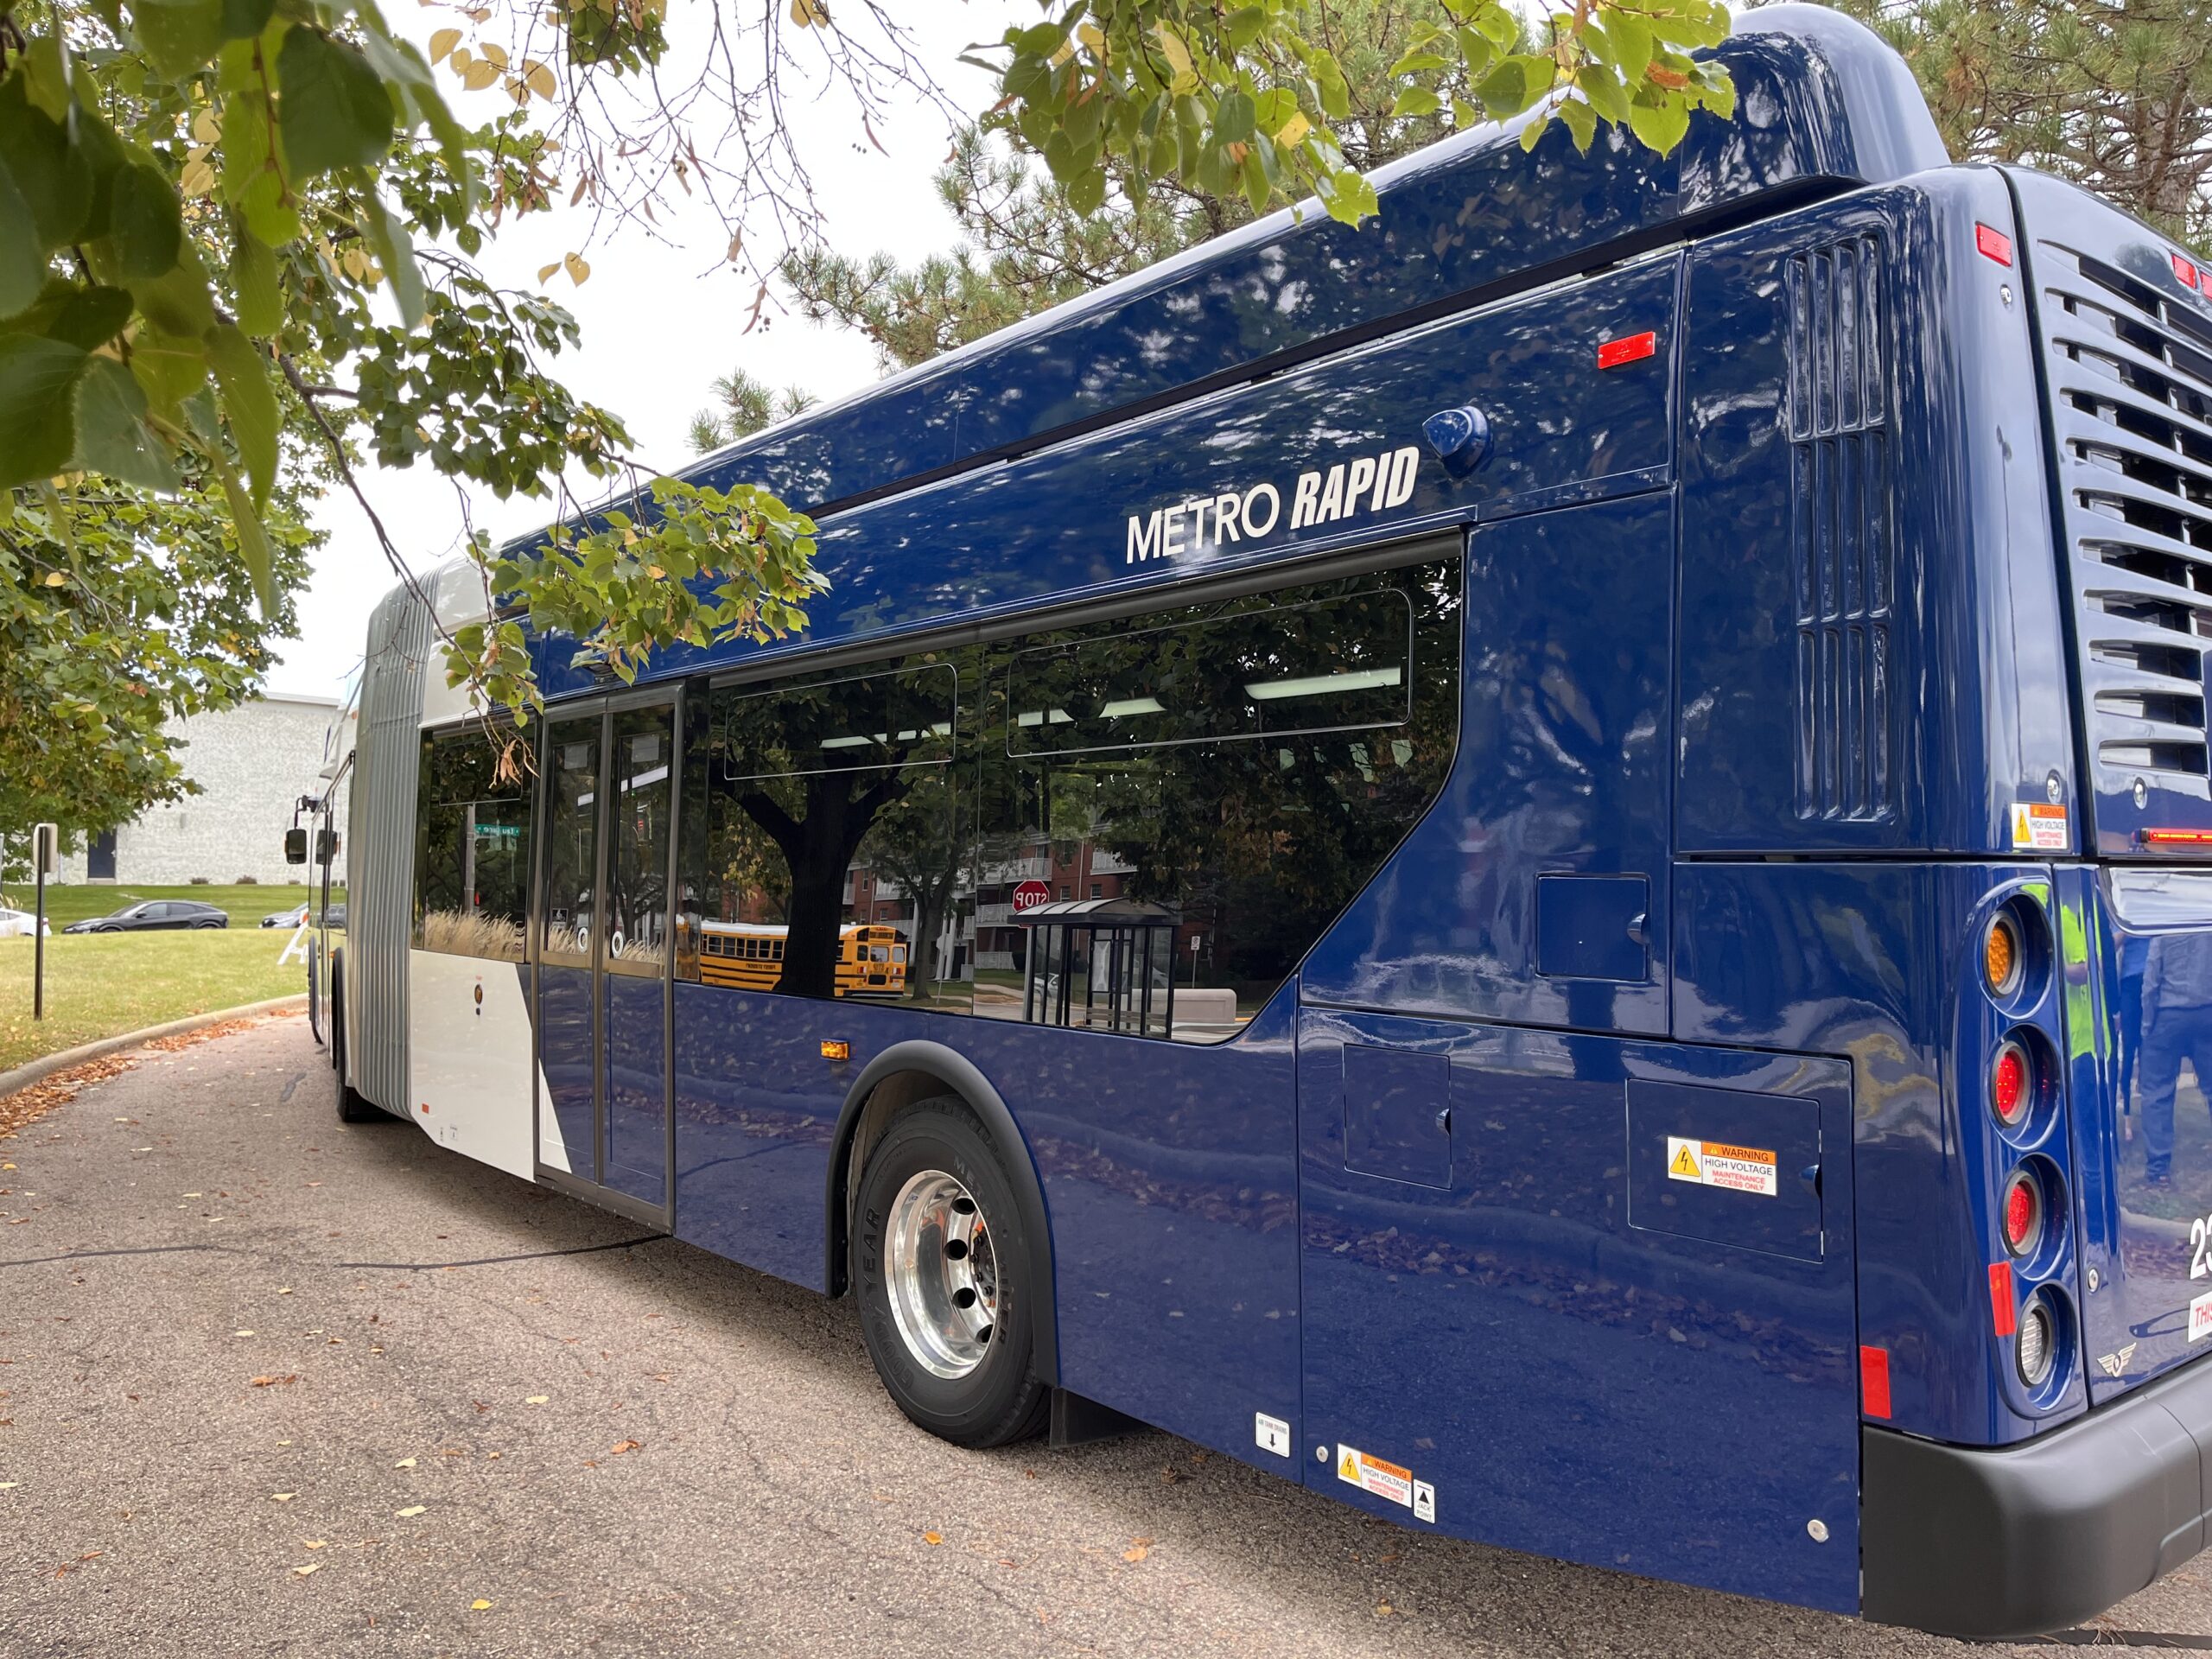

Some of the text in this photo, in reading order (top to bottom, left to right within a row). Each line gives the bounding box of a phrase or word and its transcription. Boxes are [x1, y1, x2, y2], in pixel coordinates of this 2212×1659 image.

[1127, 446, 1420, 564] METRO RAPID
[2040, 807, 2063, 817] WARNING
[2031, 821, 2064, 830] HIGH VOLTAGE
[1721, 1147, 1769, 1162] WARNING
[1705, 1158, 1773, 1176] HIGH VOLTAGE
[1712, 1170, 1766, 1185] MAINTENANCE
[1713, 1178, 1764, 1192] ACCESS ONLY
[862, 1207, 915, 1390] GOODYEAR
[1374, 1459, 1407, 1478] WARNING
[1363, 1467, 1409, 1491] HIGH VOLTAGE
[1368, 1478, 1405, 1497] MAINTENANCE
